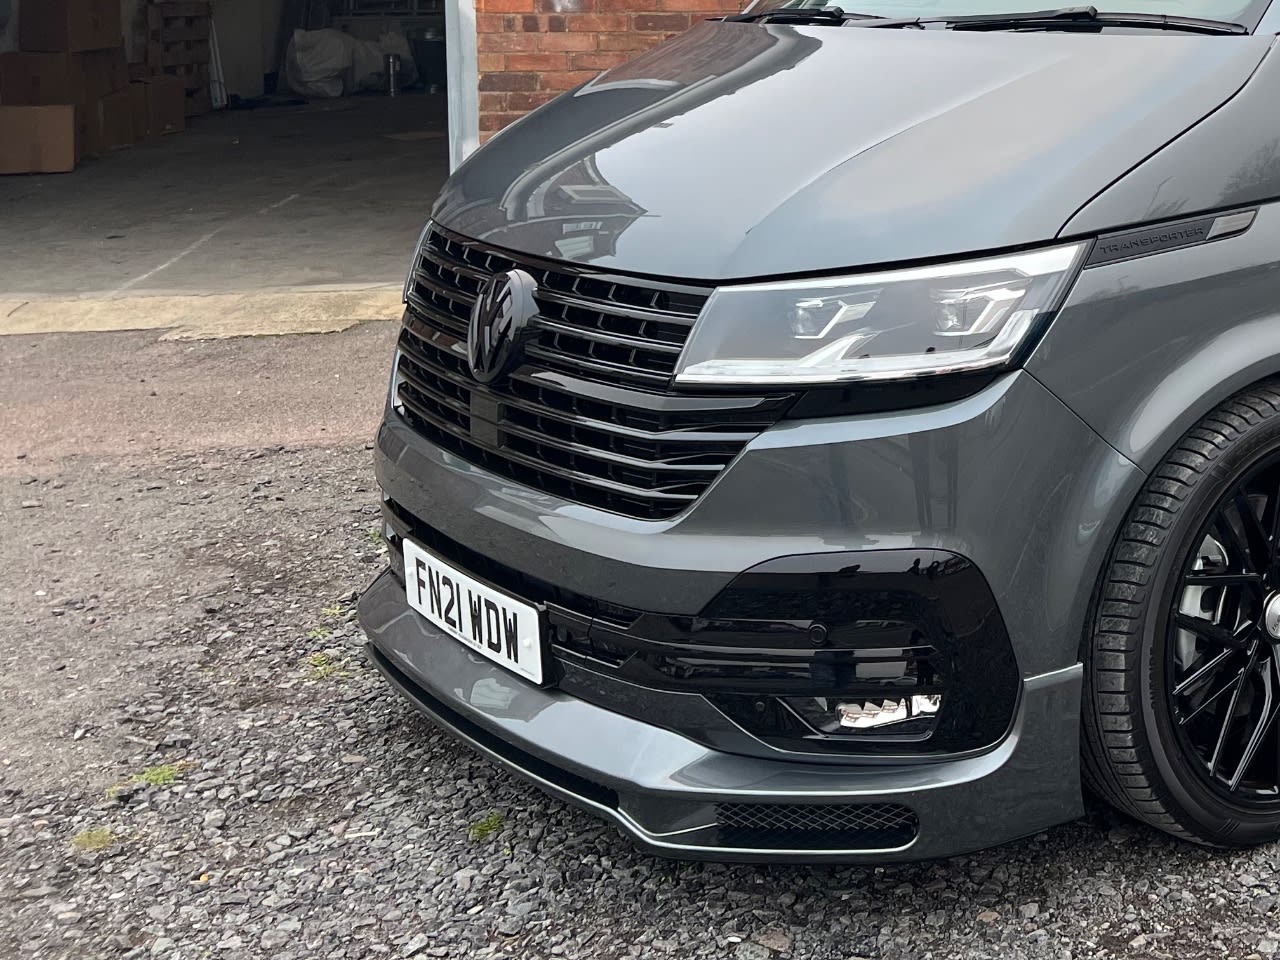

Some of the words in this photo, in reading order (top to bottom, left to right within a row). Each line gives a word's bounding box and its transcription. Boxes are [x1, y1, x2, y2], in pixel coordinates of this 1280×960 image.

[1101, 228, 1204, 254] TRANSPORTER
[416, 558, 463, 633] FN21
[468, 590, 519, 664] WDW
